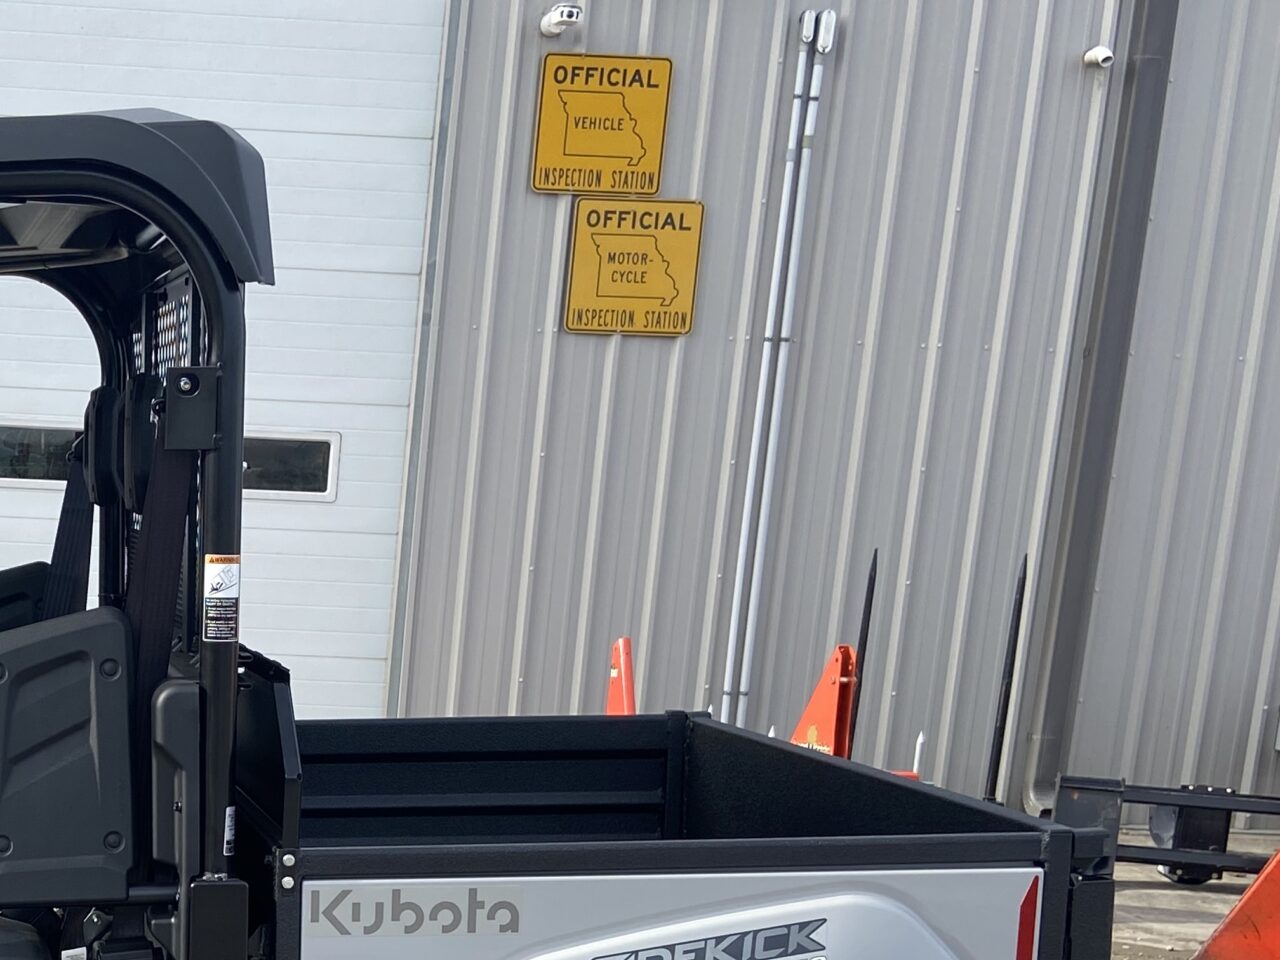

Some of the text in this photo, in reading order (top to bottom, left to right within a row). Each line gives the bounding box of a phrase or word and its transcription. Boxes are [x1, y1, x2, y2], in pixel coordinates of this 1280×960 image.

[553, 65, 660, 88] OFFICIAL
[573, 116, 625, 132] VEHICLE
[538, 167, 655, 190] INSPECTION STATION
[586, 209, 692, 231] OFFICIAL
[607, 252, 654, 266] MOTOR-
[611, 270, 647, 284] CYCLE
[571, 308, 687, 330] INSPECTION STATION
[310, 888, 520, 935] Kubota
